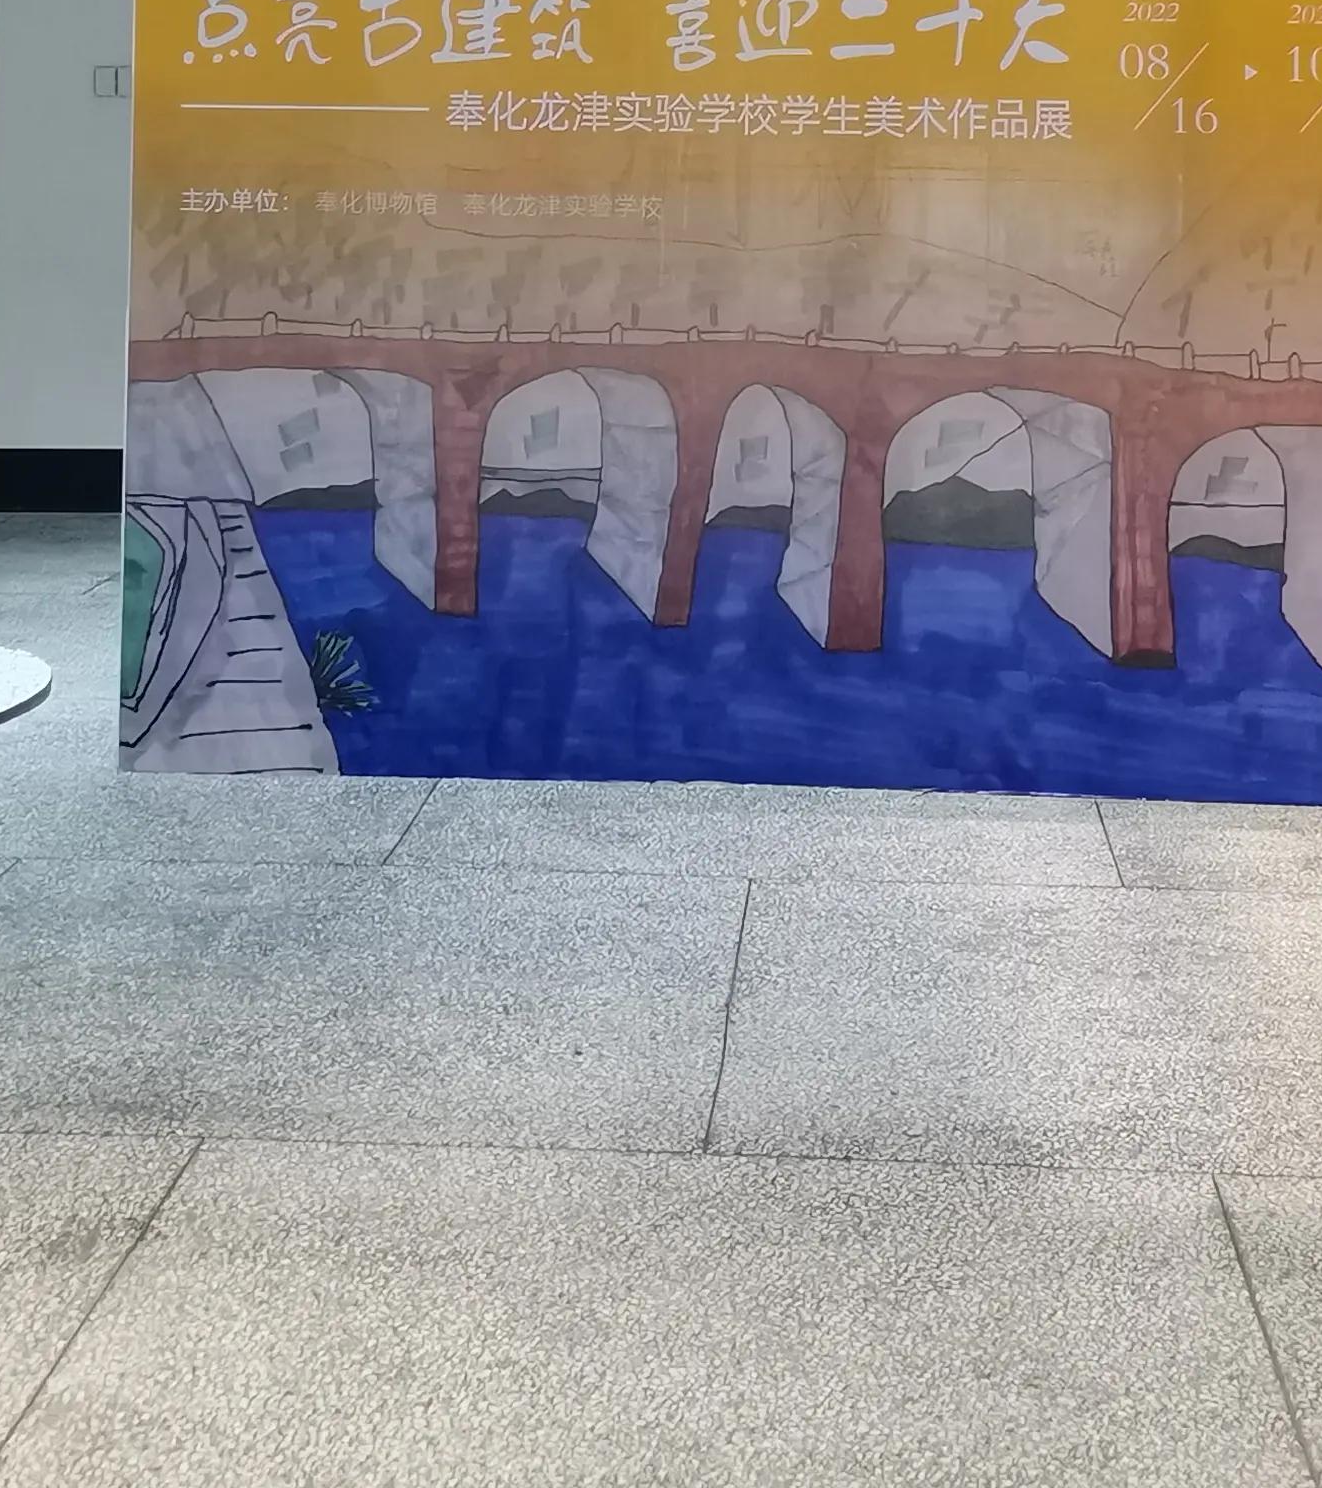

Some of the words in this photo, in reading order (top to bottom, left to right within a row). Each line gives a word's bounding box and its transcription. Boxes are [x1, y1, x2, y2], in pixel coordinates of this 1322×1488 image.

[1122, 1, 1180, 23] 2022
[445, 90, 1074, 141] 奉化龙津实验学校学生美术作品展
[313, 190, 439, 216] 奉化博物馆
[462, 193, 664, 223] 奉化龙津实验学校
